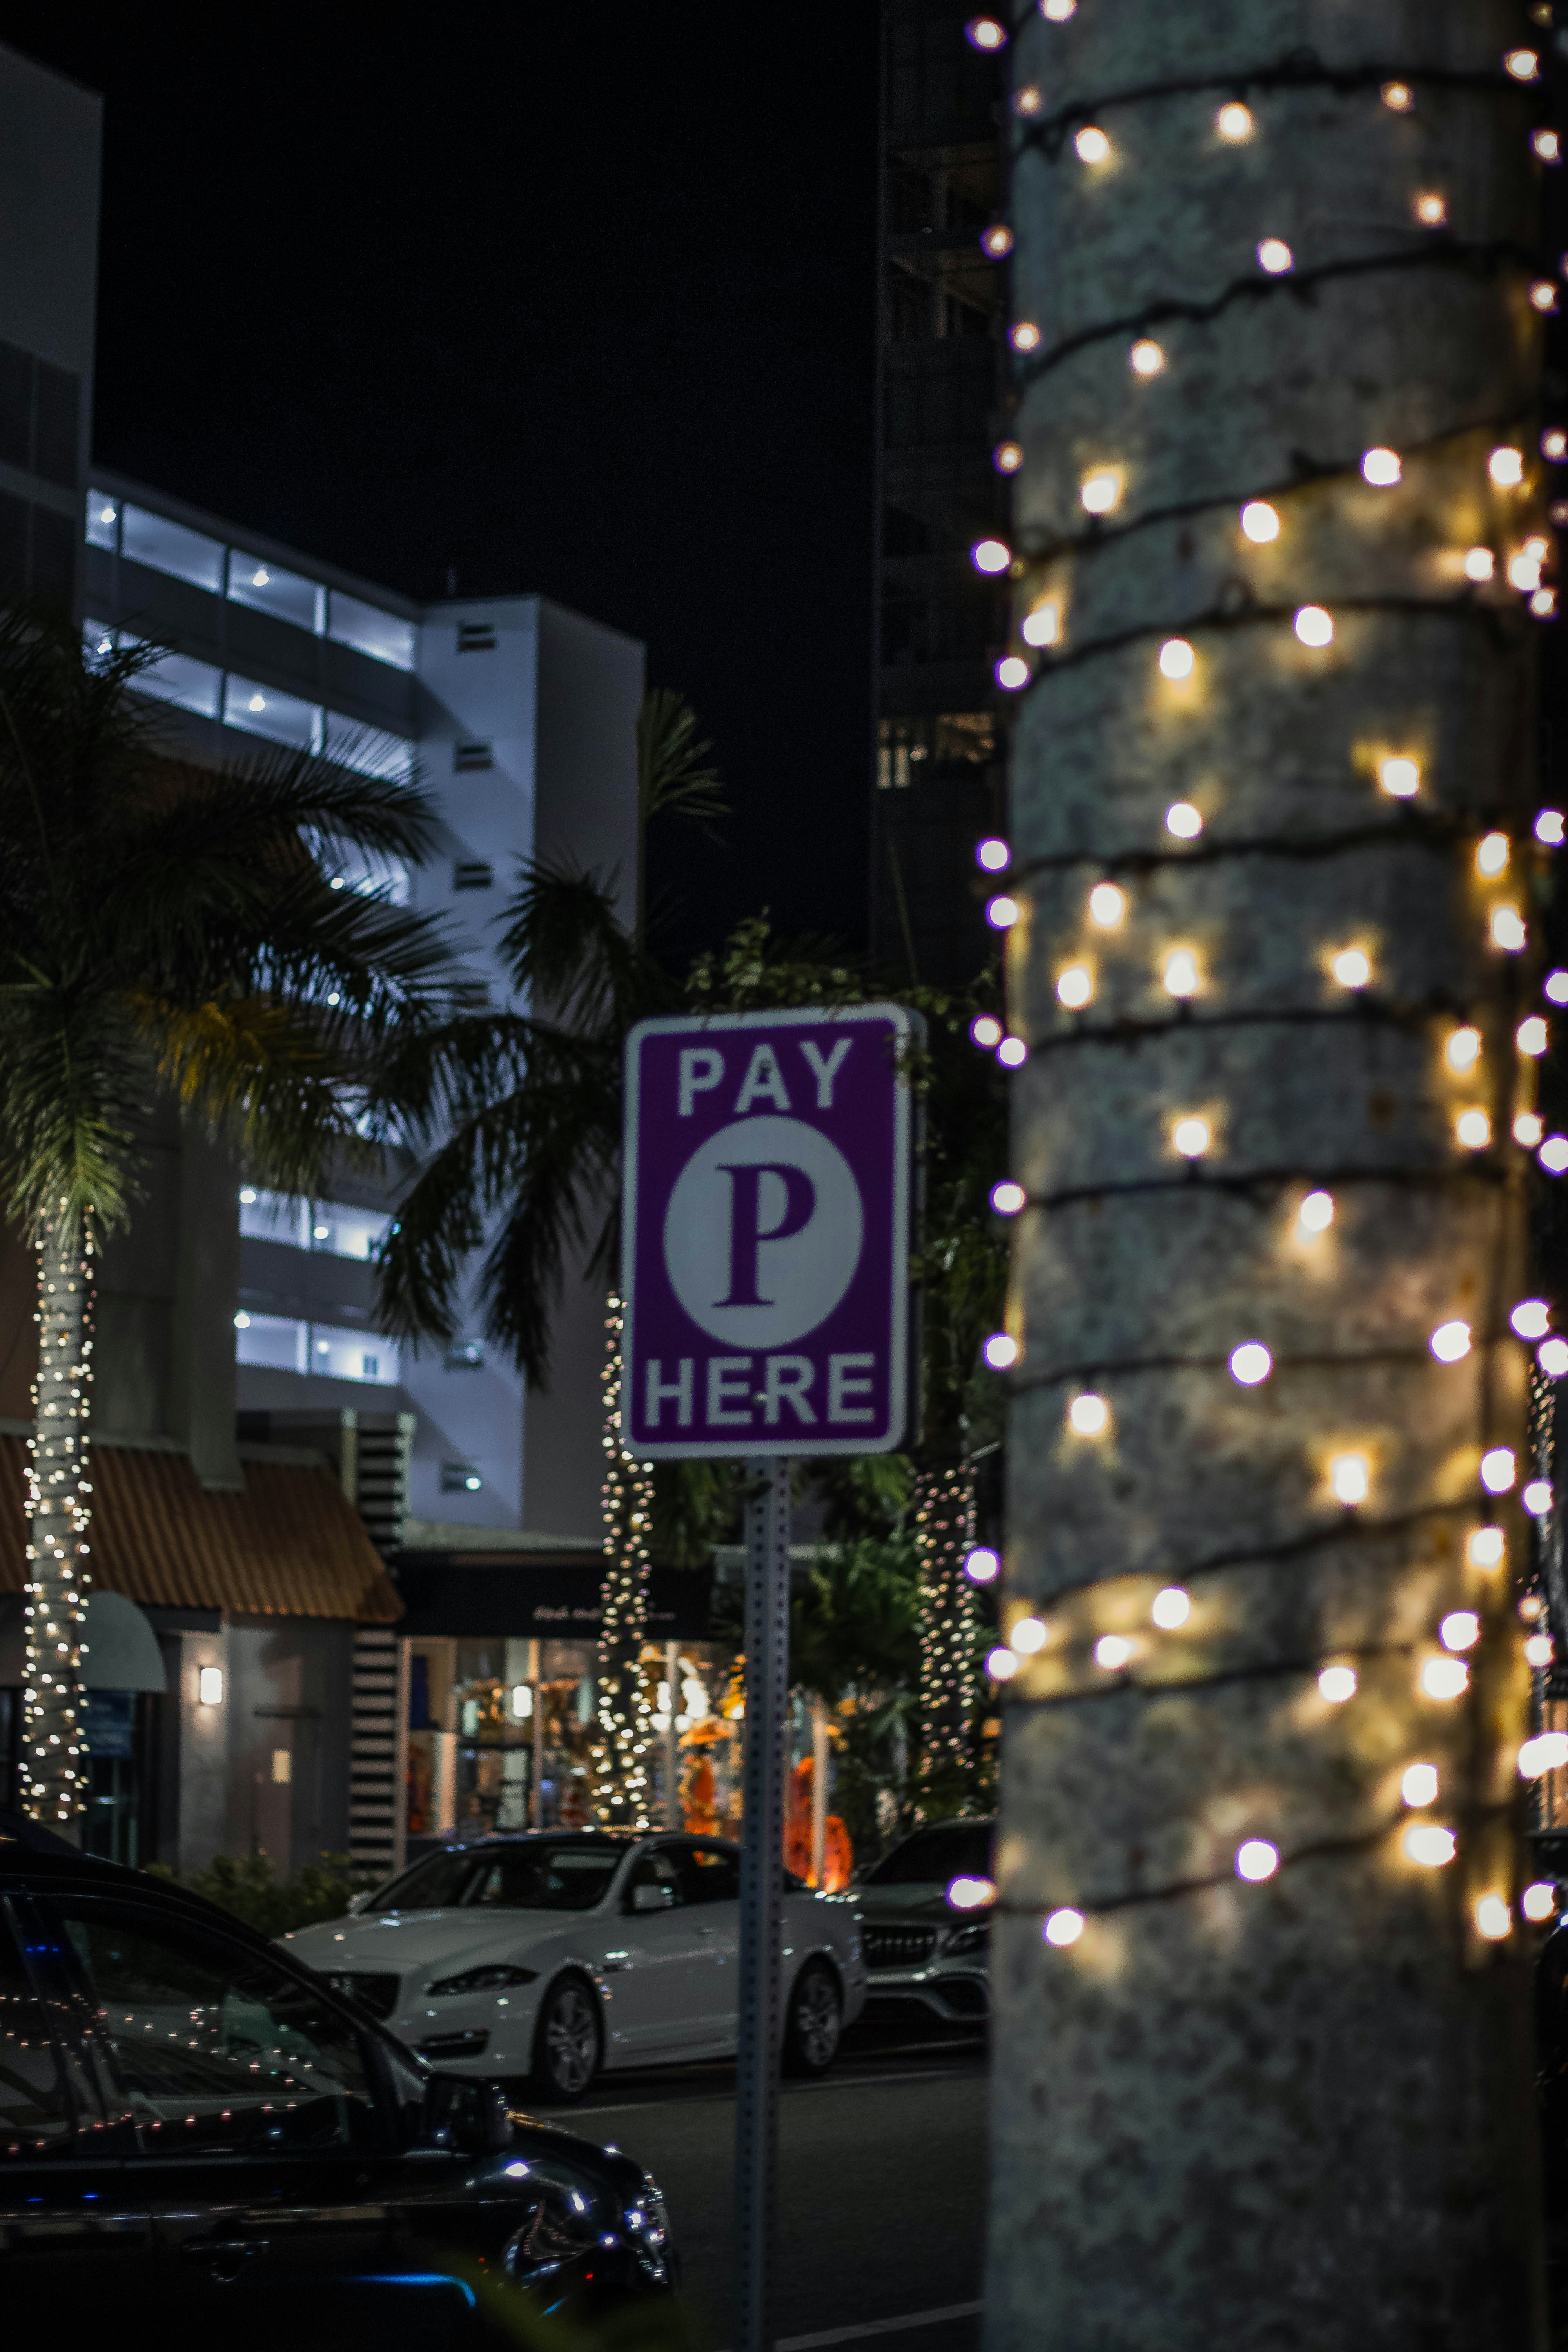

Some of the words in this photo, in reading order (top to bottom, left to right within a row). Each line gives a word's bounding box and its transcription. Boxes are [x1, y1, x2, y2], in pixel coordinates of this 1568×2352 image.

[678, 1038, 853, 1116] PAY
[711, 1162, 817, 1308] P
[644, 1352, 875, 1427] HERE
